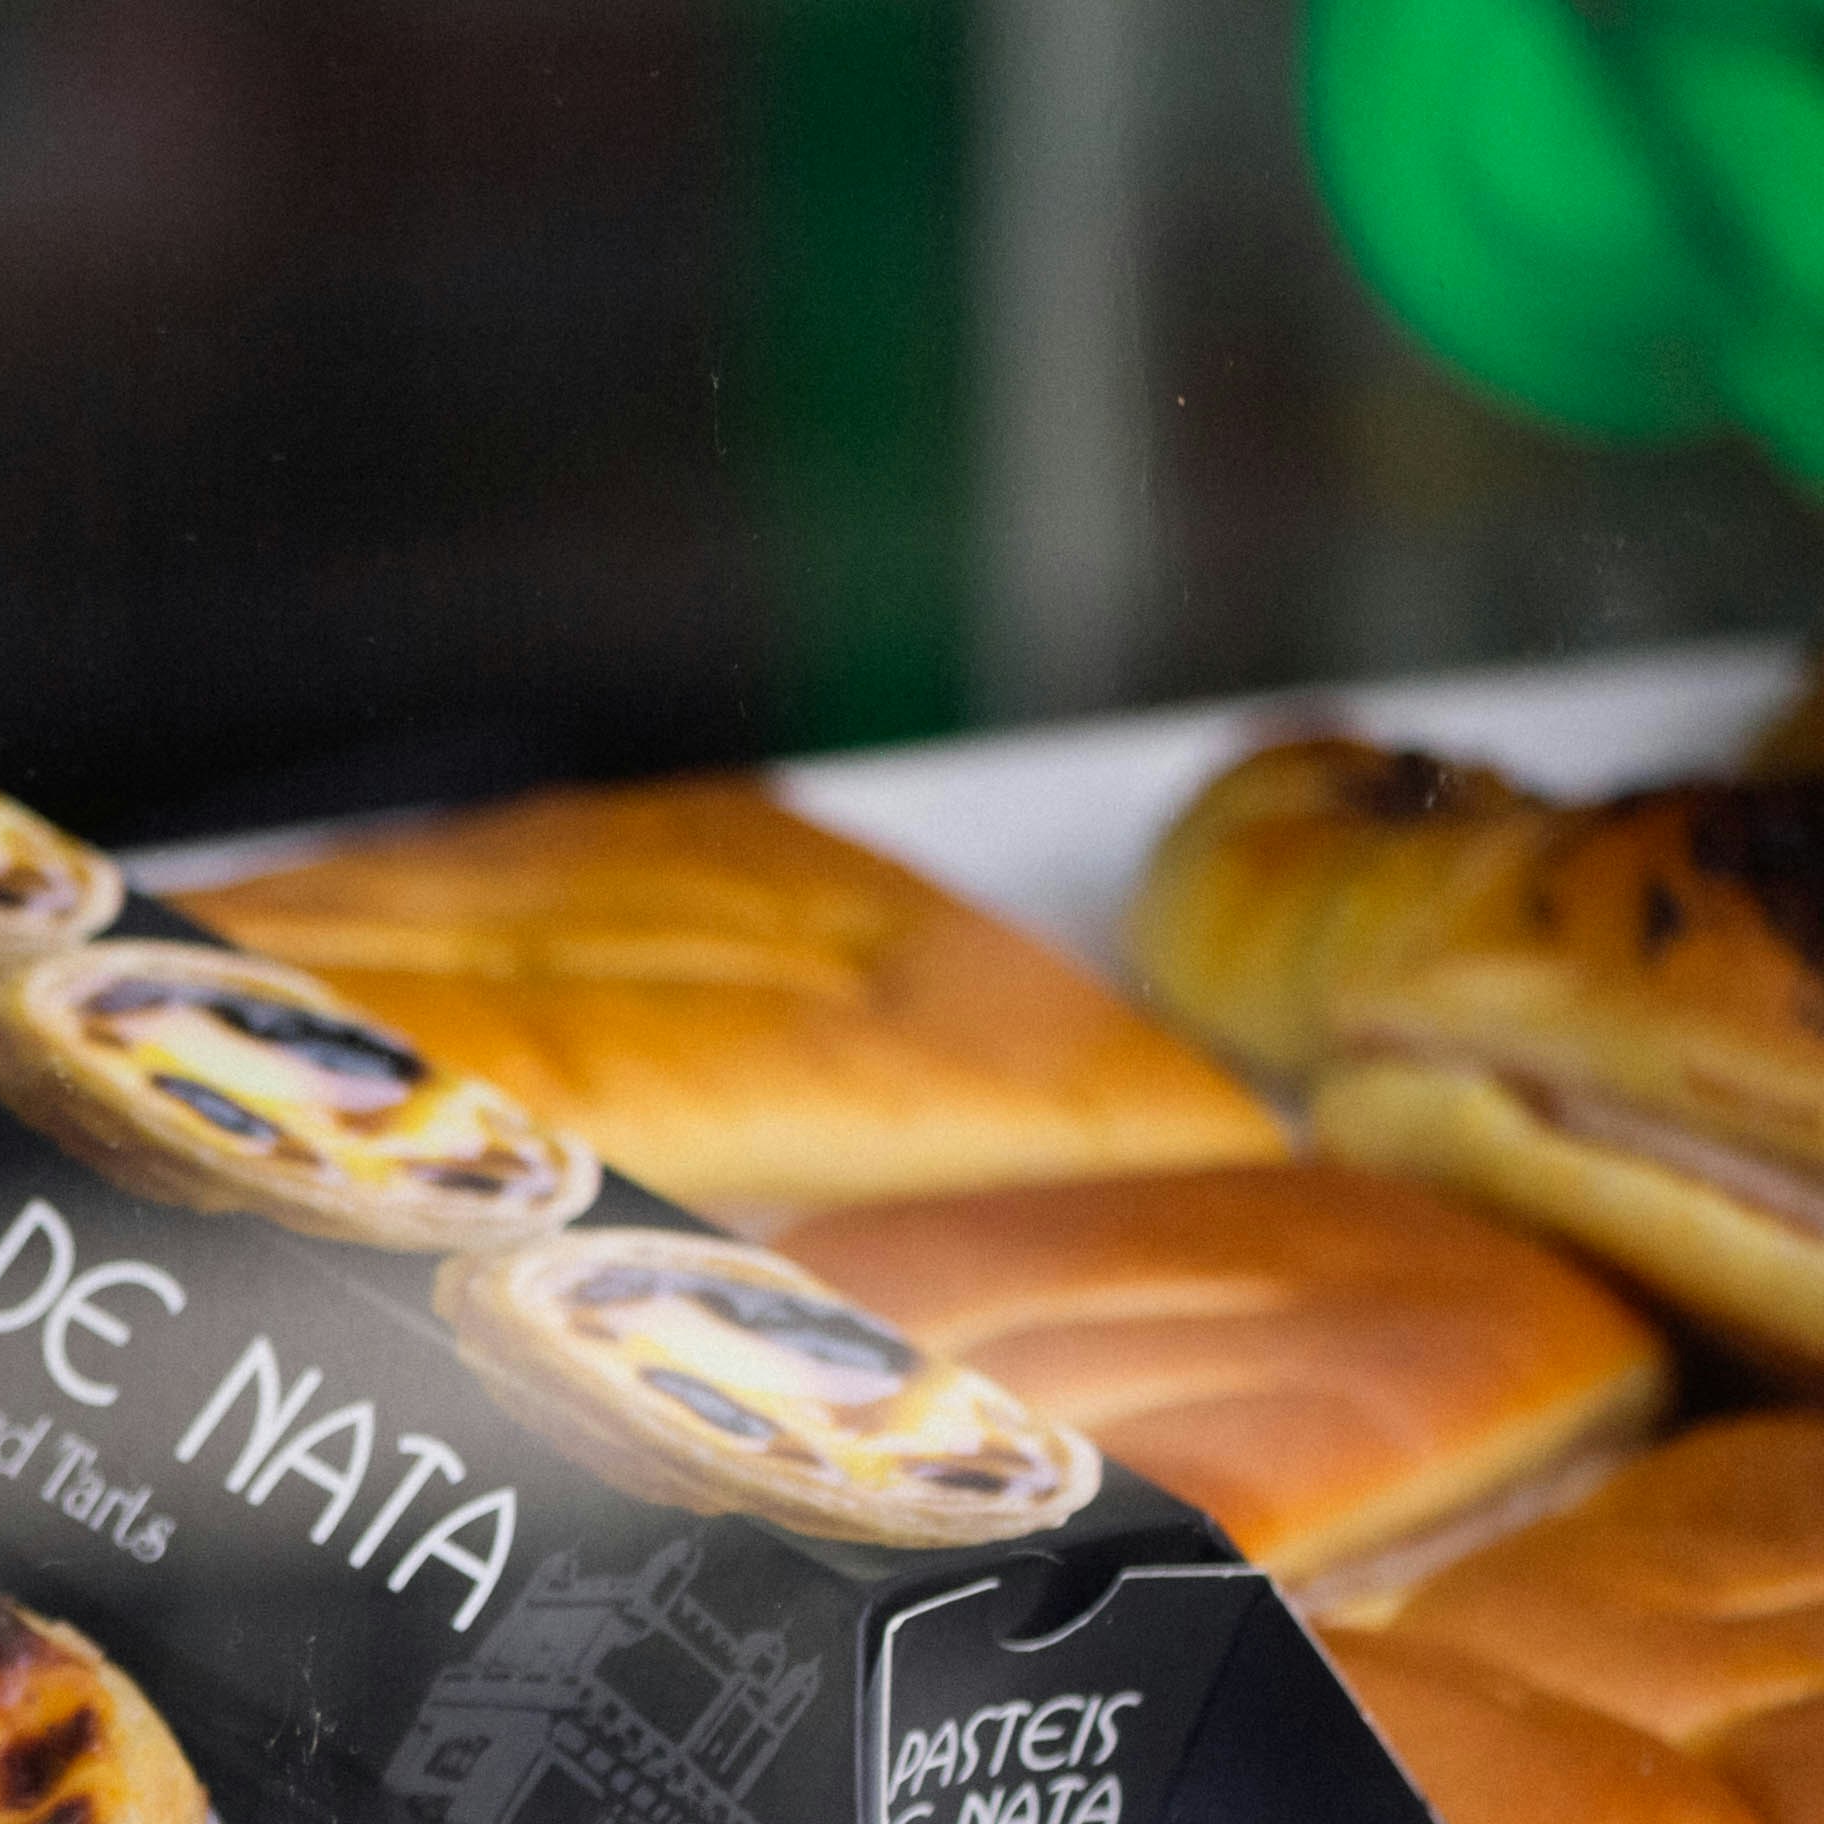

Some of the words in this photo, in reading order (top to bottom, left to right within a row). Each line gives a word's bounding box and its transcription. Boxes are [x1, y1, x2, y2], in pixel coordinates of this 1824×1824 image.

[39, 1433, 177, 1564] Tarts
[178, 1336, 520, 1633] NATA
[888, 1690, 1143, 1806] PASTEIS
